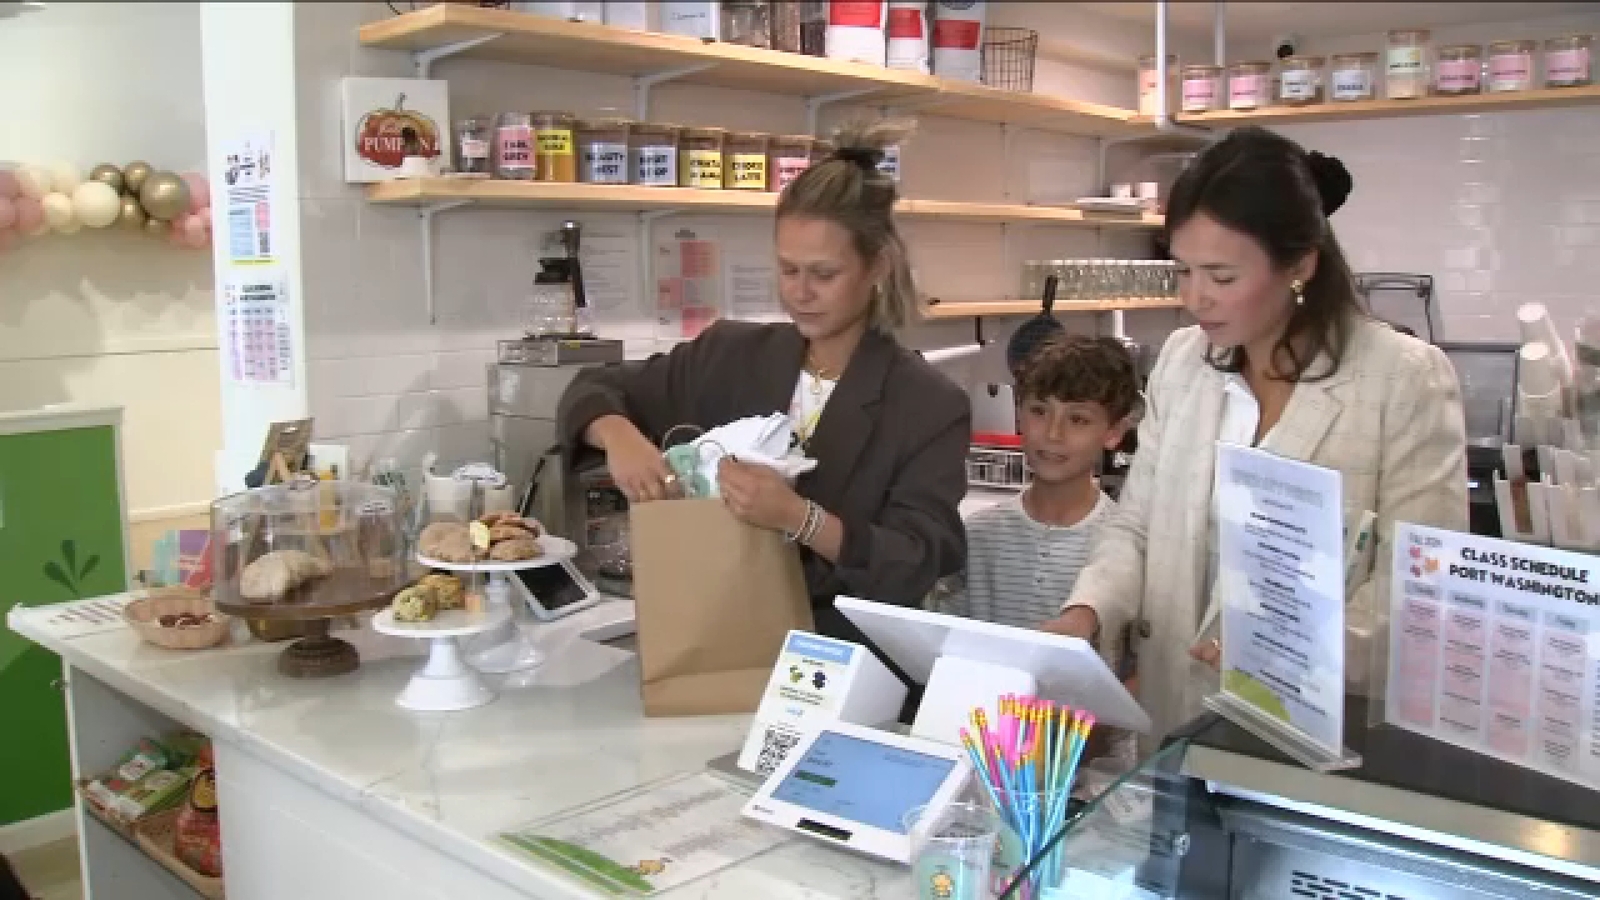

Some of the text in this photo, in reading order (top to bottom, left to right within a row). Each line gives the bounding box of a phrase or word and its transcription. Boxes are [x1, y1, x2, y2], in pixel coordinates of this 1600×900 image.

[1449, 563, 1488, 583] PORT
[1490, 571, 1600, 606] WASHINGTON
[1460, 546, 1591, 584] CLASS SCHEDULE
